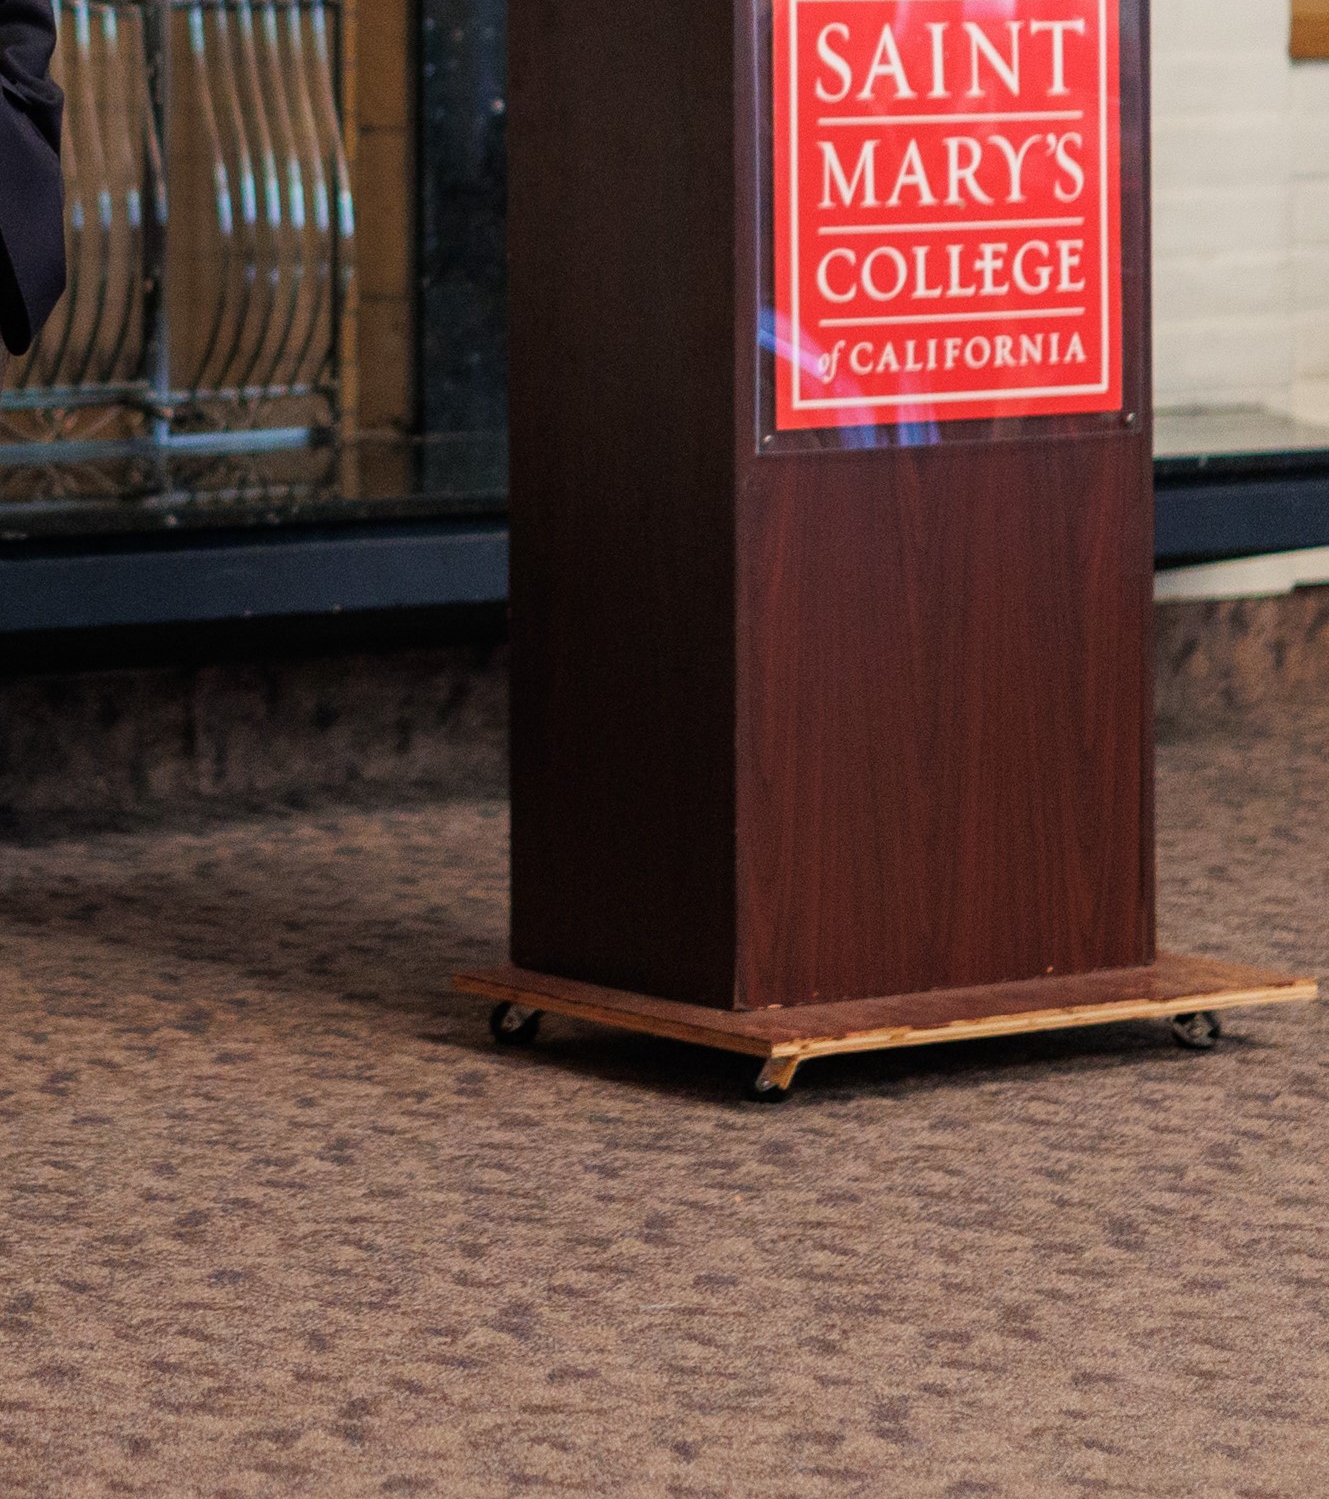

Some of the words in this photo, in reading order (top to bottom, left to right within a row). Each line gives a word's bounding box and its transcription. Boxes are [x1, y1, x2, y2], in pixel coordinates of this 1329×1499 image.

[814, 18, 1086, 102] SAINT
[817, 131, 1085, 209] MARY'S
[816, 238, 1086, 302] COLLEGE
[817, 338, 846, 383] of
[849, 331, 1087, 375] CALIFORNIA
